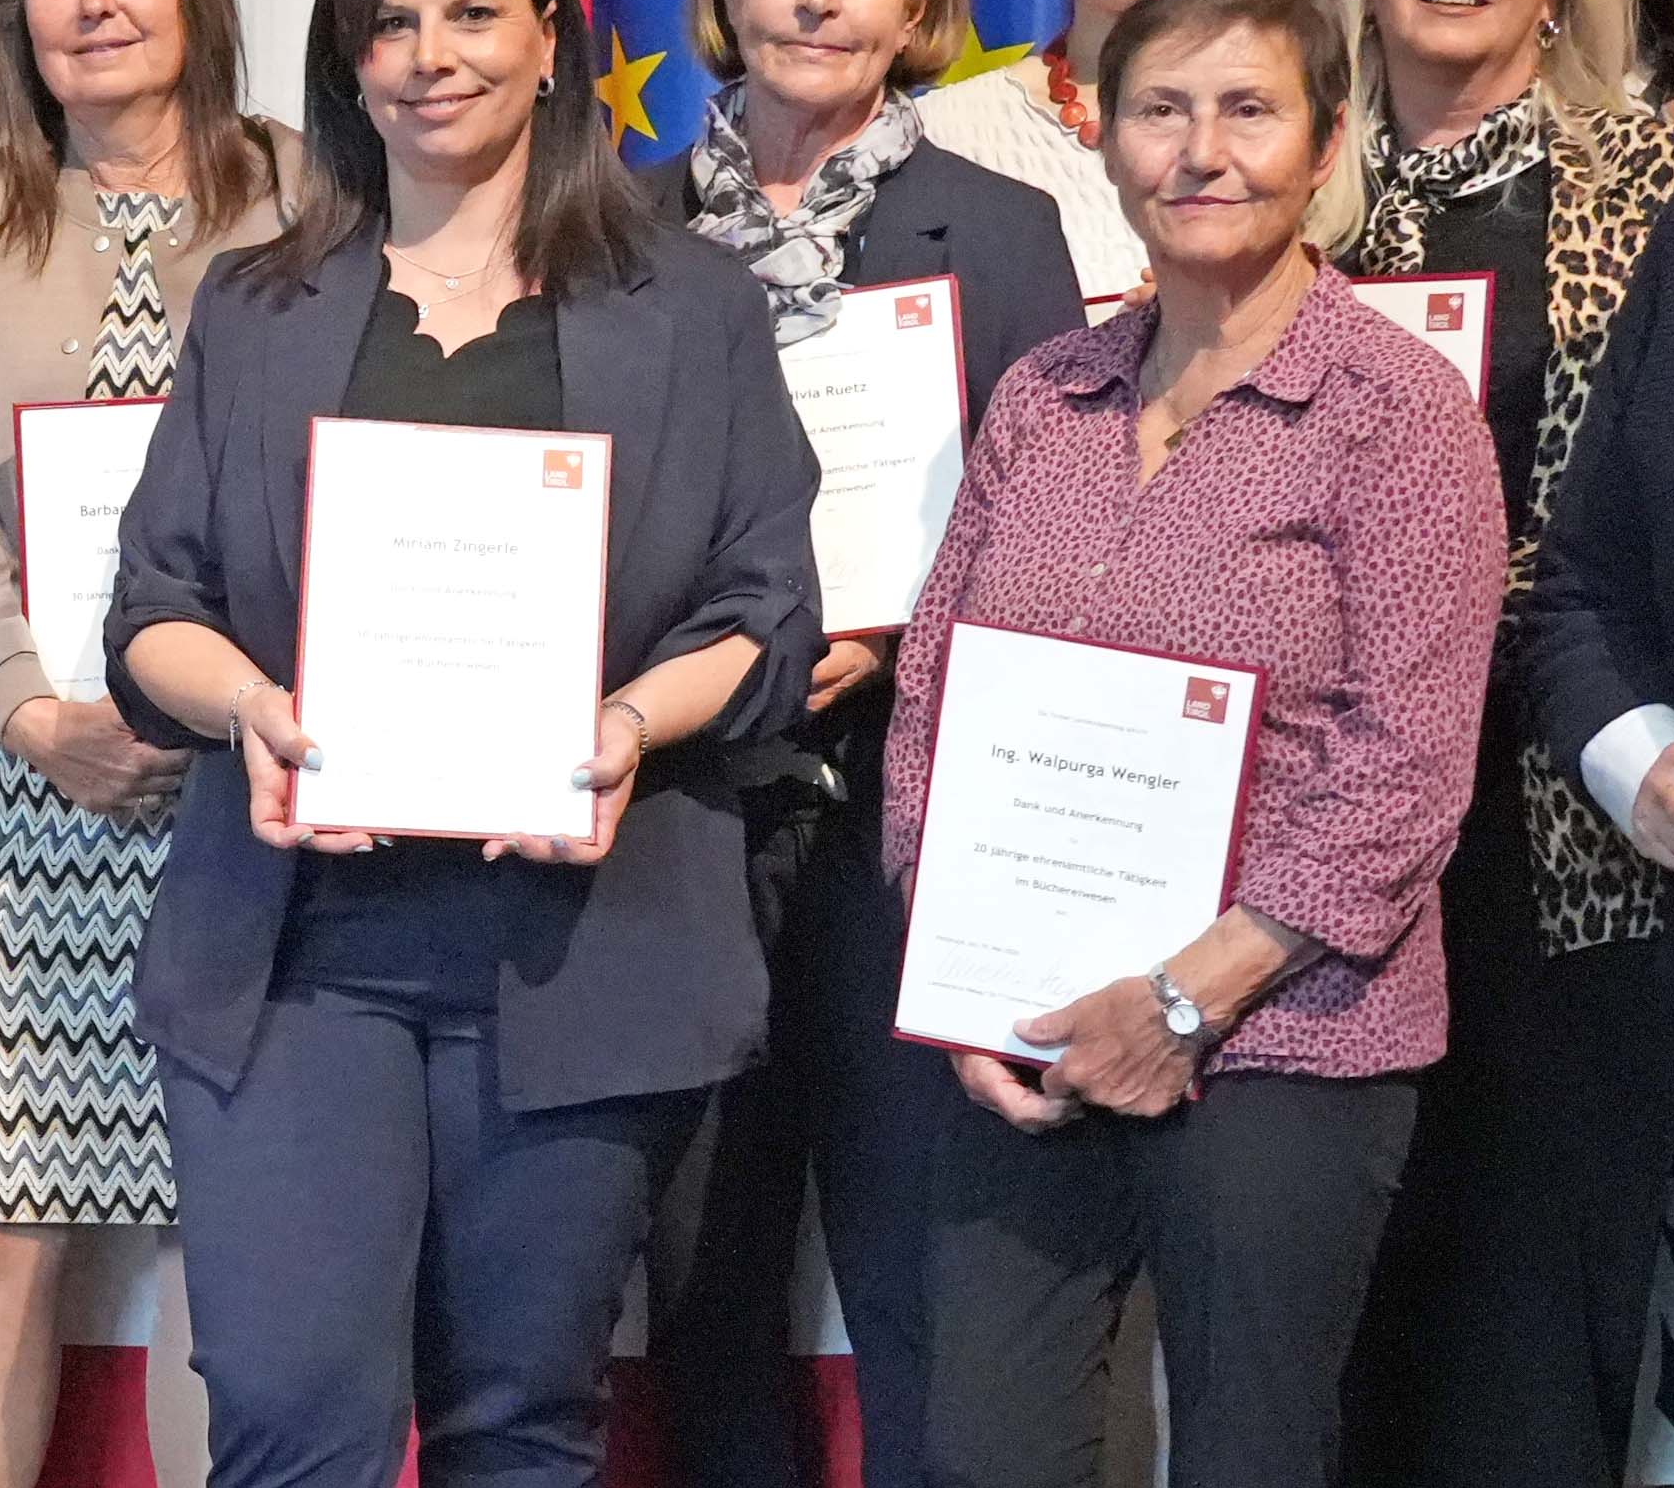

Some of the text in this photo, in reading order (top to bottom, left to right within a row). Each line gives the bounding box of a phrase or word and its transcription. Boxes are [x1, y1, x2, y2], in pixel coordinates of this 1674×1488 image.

[825, 382, 869, 397] Ruetz
[393, 536, 518, 557] Miriam Zingerle
[990, 744, 1181, 791] Ing. Walpurga Wengler
[1013, 797, 1144, 833] Dank und Anerkennung
[973, 841, 987, 853] 20
[1033, 853, 1114, 878] ehrenamtliche
[1015, 875, 1029, 888] im
